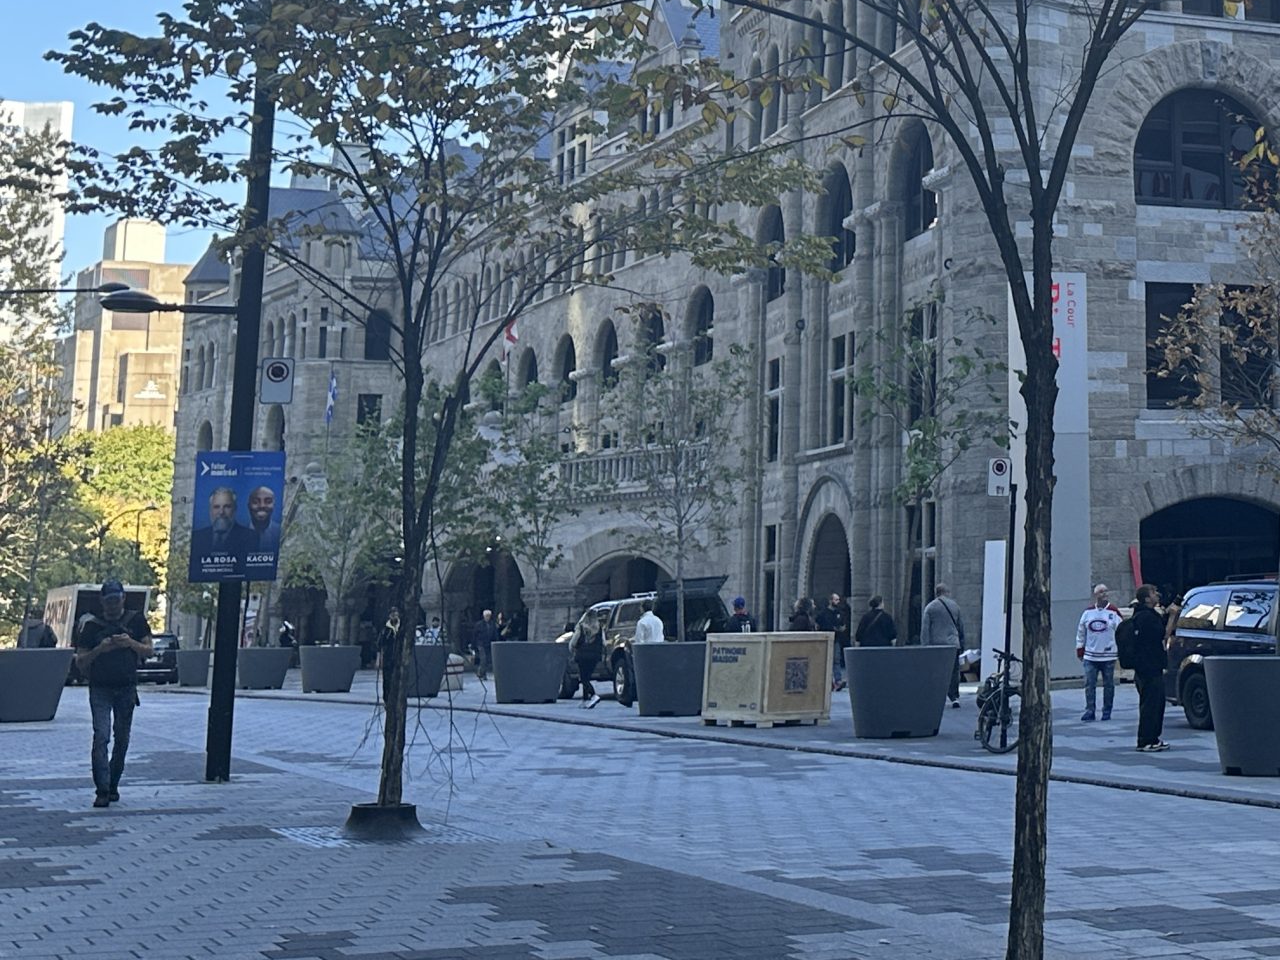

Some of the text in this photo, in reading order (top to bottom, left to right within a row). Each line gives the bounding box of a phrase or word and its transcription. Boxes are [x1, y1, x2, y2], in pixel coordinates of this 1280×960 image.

[1066, 282, 1076, 328] La Cour
[201, 556, 212, 564] LA
